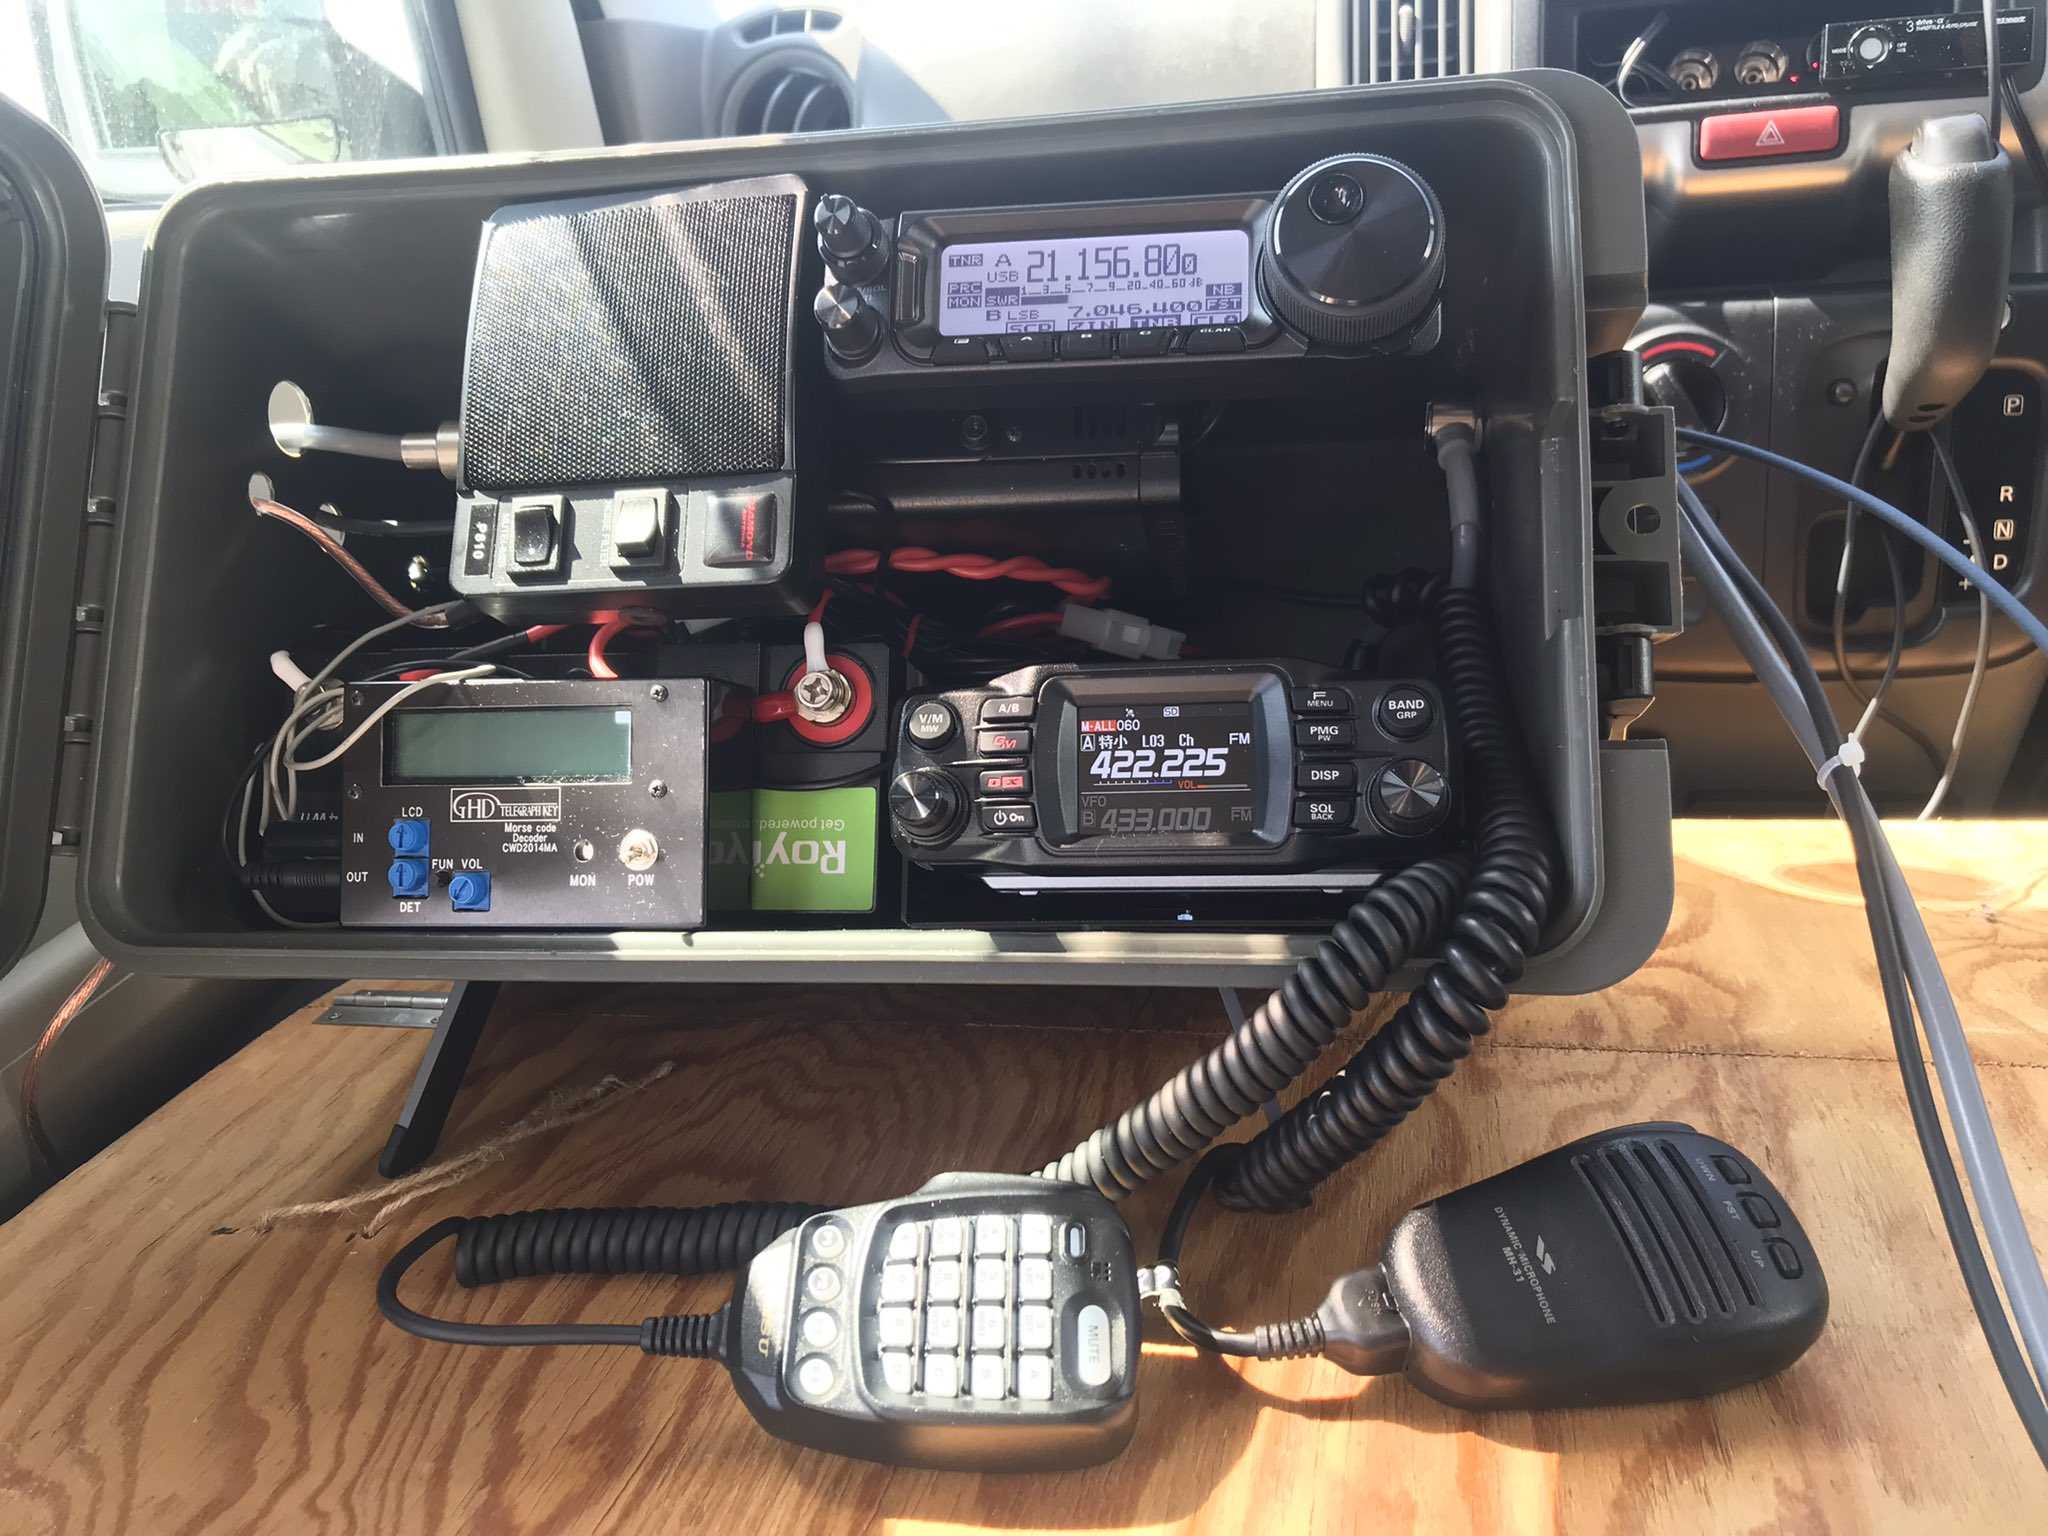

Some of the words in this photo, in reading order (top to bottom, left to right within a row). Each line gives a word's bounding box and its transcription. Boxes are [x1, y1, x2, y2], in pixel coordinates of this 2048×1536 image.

[950, 254, 983, 267] TNR
[995, 254, 1012, 267] A
[1027, 244, 1198, 283] 21.156.800
[987, 271, 1019, 283] USB
[949, 282, 983, 295] PRC
[1212, 284, 1235, 295] NB
[948, 296, 982, 309] MON
[986, 295, 1019, 307] SWR
[1207, 299, 1241, 311] FST
[986, 310, 1001, 321] B
[1007, 309, 1040, 321] LSB
[1068, 301, 1202, 318] 7.046.400
[2005, 396, 2022, 414] P
[1999, 486, 2014, 502] R
[1995, 521, 2012, 539] N
[1993, 554, 2008, 570] D
[998, 703, 1020, 713] A/B
[1388, 699, 1425, 710] BAND
[1163, 706, 1180, 717] SD
[1397, 711, 1417, 720] GRP
[919, 713, 943, 723] V/M
[920, 725, 940, 733] MW
[1117, 719, 1141, 731] 060
[1310, 726, 1339, 736] PMG
[1082, 736, 1095, 750] A
[1142, 735, 1165, 748] L03
[1179, 734, 1195, 747] Ch
[1229, 733, 1251, 745] FM
[1090, 748, 1229, 779] 422.225
[1311, 770, 1340, 780] DISP
[1178, 780, 1198, 789] VOL
[453, 792, 500, 819] GHD
[1082, 796, 1107, 808] VFO
[402, 806, 423, 818] LCD
[1310, 803, 1335, 814] SQL
[759, 818, 817, 832] powered
[821, 818, 846, 832] Get
[1083, 812, 1096, 825] B
[1101, 807, 1212, 832] 433.000
[1231, 807, 1252, 821] FM
[504, 822, 532, 833] Morse
[536, 823, 557, 833] code
[353, 833, 364, 844] IN
[512, 833, 548, 843] Decoder
[502, 842, 558, 853] CWD2014MA
[431, 858, 454, 870] FUN
[461, 858, 483, 870] VOL
[346, 872, 368, 883] OUT
[569, 874, 596, 887] MON
[628, 874, 655, 887] POW
[400, 902, 421, 914] DET
[1494, 1206, 1522, 1250] DYNAMIC
[1518, 1252, 1556, 1324] MICROPHONE
[1502, 1246, 1525, 1282] MH-31
[1087, 1324, 1100, 1365] MUTE
